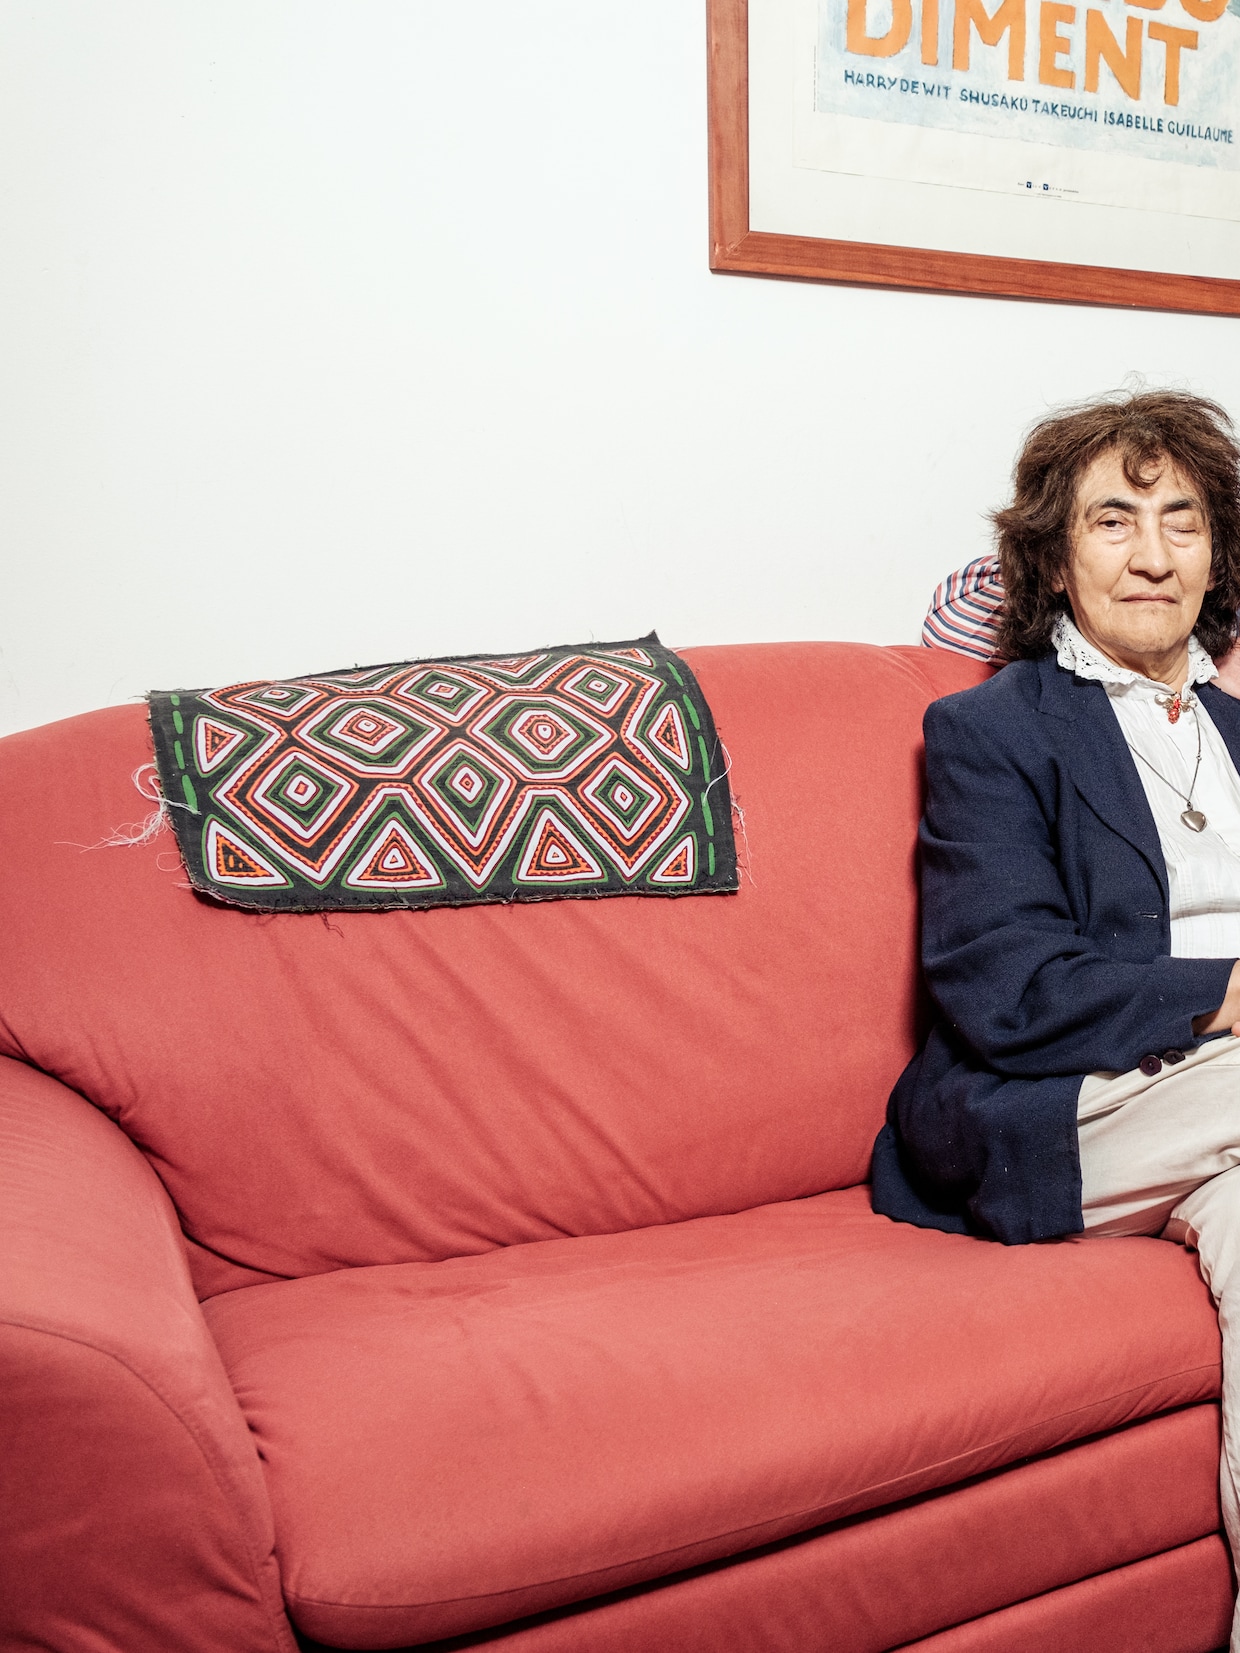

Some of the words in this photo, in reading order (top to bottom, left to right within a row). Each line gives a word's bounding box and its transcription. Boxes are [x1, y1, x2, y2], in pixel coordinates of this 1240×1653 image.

[845, 0, 1198, 106] DIMENT
[843, 69, 898, 90] HARRY
[900, 79, 920, 95] DE
[921, 84, 951, 100] WIT
[959, 87, 1029, 112] SHUSAKU
[1032, 98, 1099, 123] TAKEUCHI
[1103, 110, 1164, 133] ISABELLE
[1167, 121, 1235, 144] GUILLAUME
